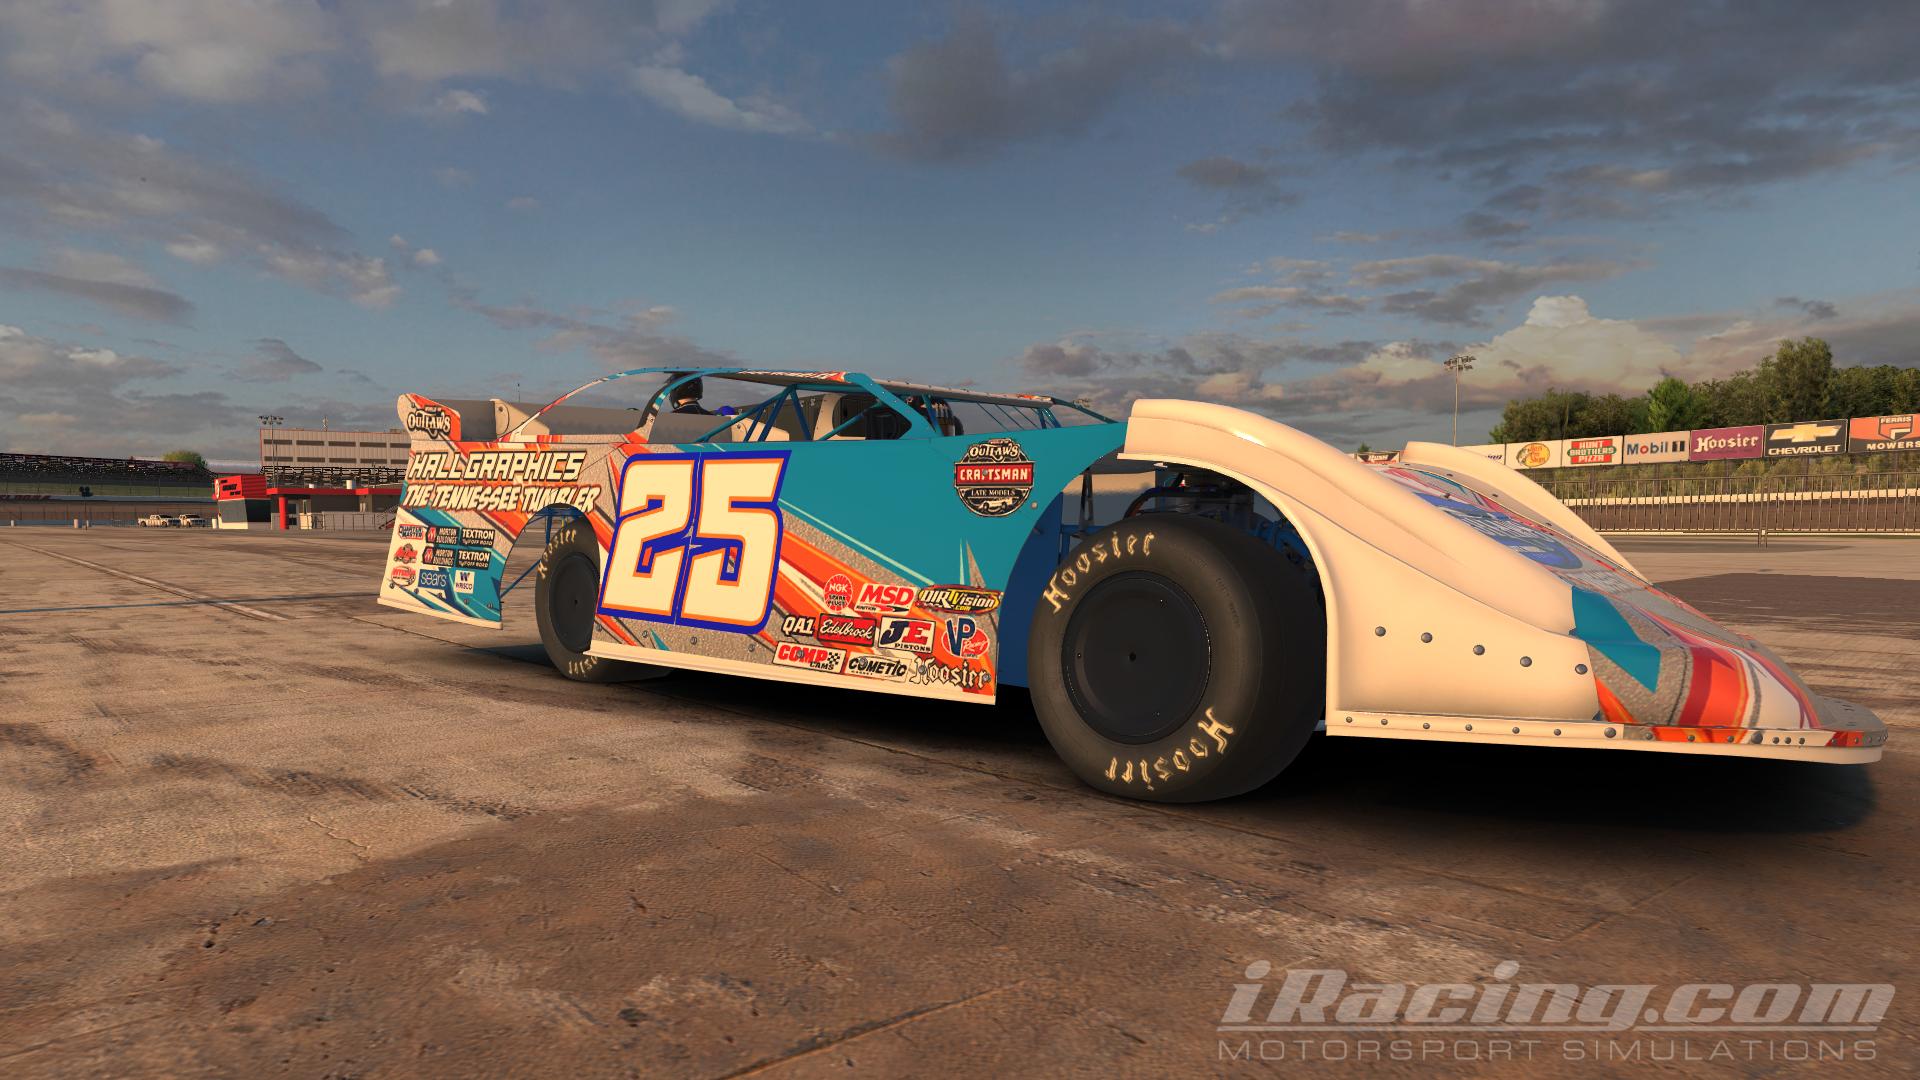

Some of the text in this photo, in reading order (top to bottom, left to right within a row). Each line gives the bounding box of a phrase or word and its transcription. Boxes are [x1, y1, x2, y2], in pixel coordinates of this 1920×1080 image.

[1880, 416, 1912, 424] FERRIS
[1569, 447, 1615, 456] BROTHERS
[1579, 441, 1604, 449] HUNT
[1626, 440, 1669, 456] Mobil
[1693, 433, 1759, 453] Hoosier
[1768, 444, 1841, 456] CHEVROLET
[1866, 440, 1920, 451] MOWERS
[968, 443, 1019, 462] OUTLAWS
[1578, 454, 1605, 463] PIZZA
[408, 451, 587, 482] HALL GRAPHICS
[402, 483, 434, 507] THE
[431, 483, 523, 512] TENNESSEE
[971, 488, 1016, 497] LATE MODELS
[462, 529, 494, 540] TEXTRON
[599, 455, 787, 629] 25
[458, 550, 490, 562] TEXTRON
[420, 571, 447, 587] sears
[1043, 531, 1155, 614] Hoosier
[828, 583, 848, 593] NGK
[860, 585, 914, 606] MSD
[781, 615, 815, 636] QA1
[819, 618, 873, 640] Edelbrock
[879, 619, 931, 646] JE
[945, 616, 977, 657] VP
[778, 644, 829, 664] COMP
[894, 642, 932, 652] PISTONS
[810, 661, 835, 671] CAMS
[909, 656, 989, 690] Hoosier
[1105, 707, 1234, 791] Hoosier
